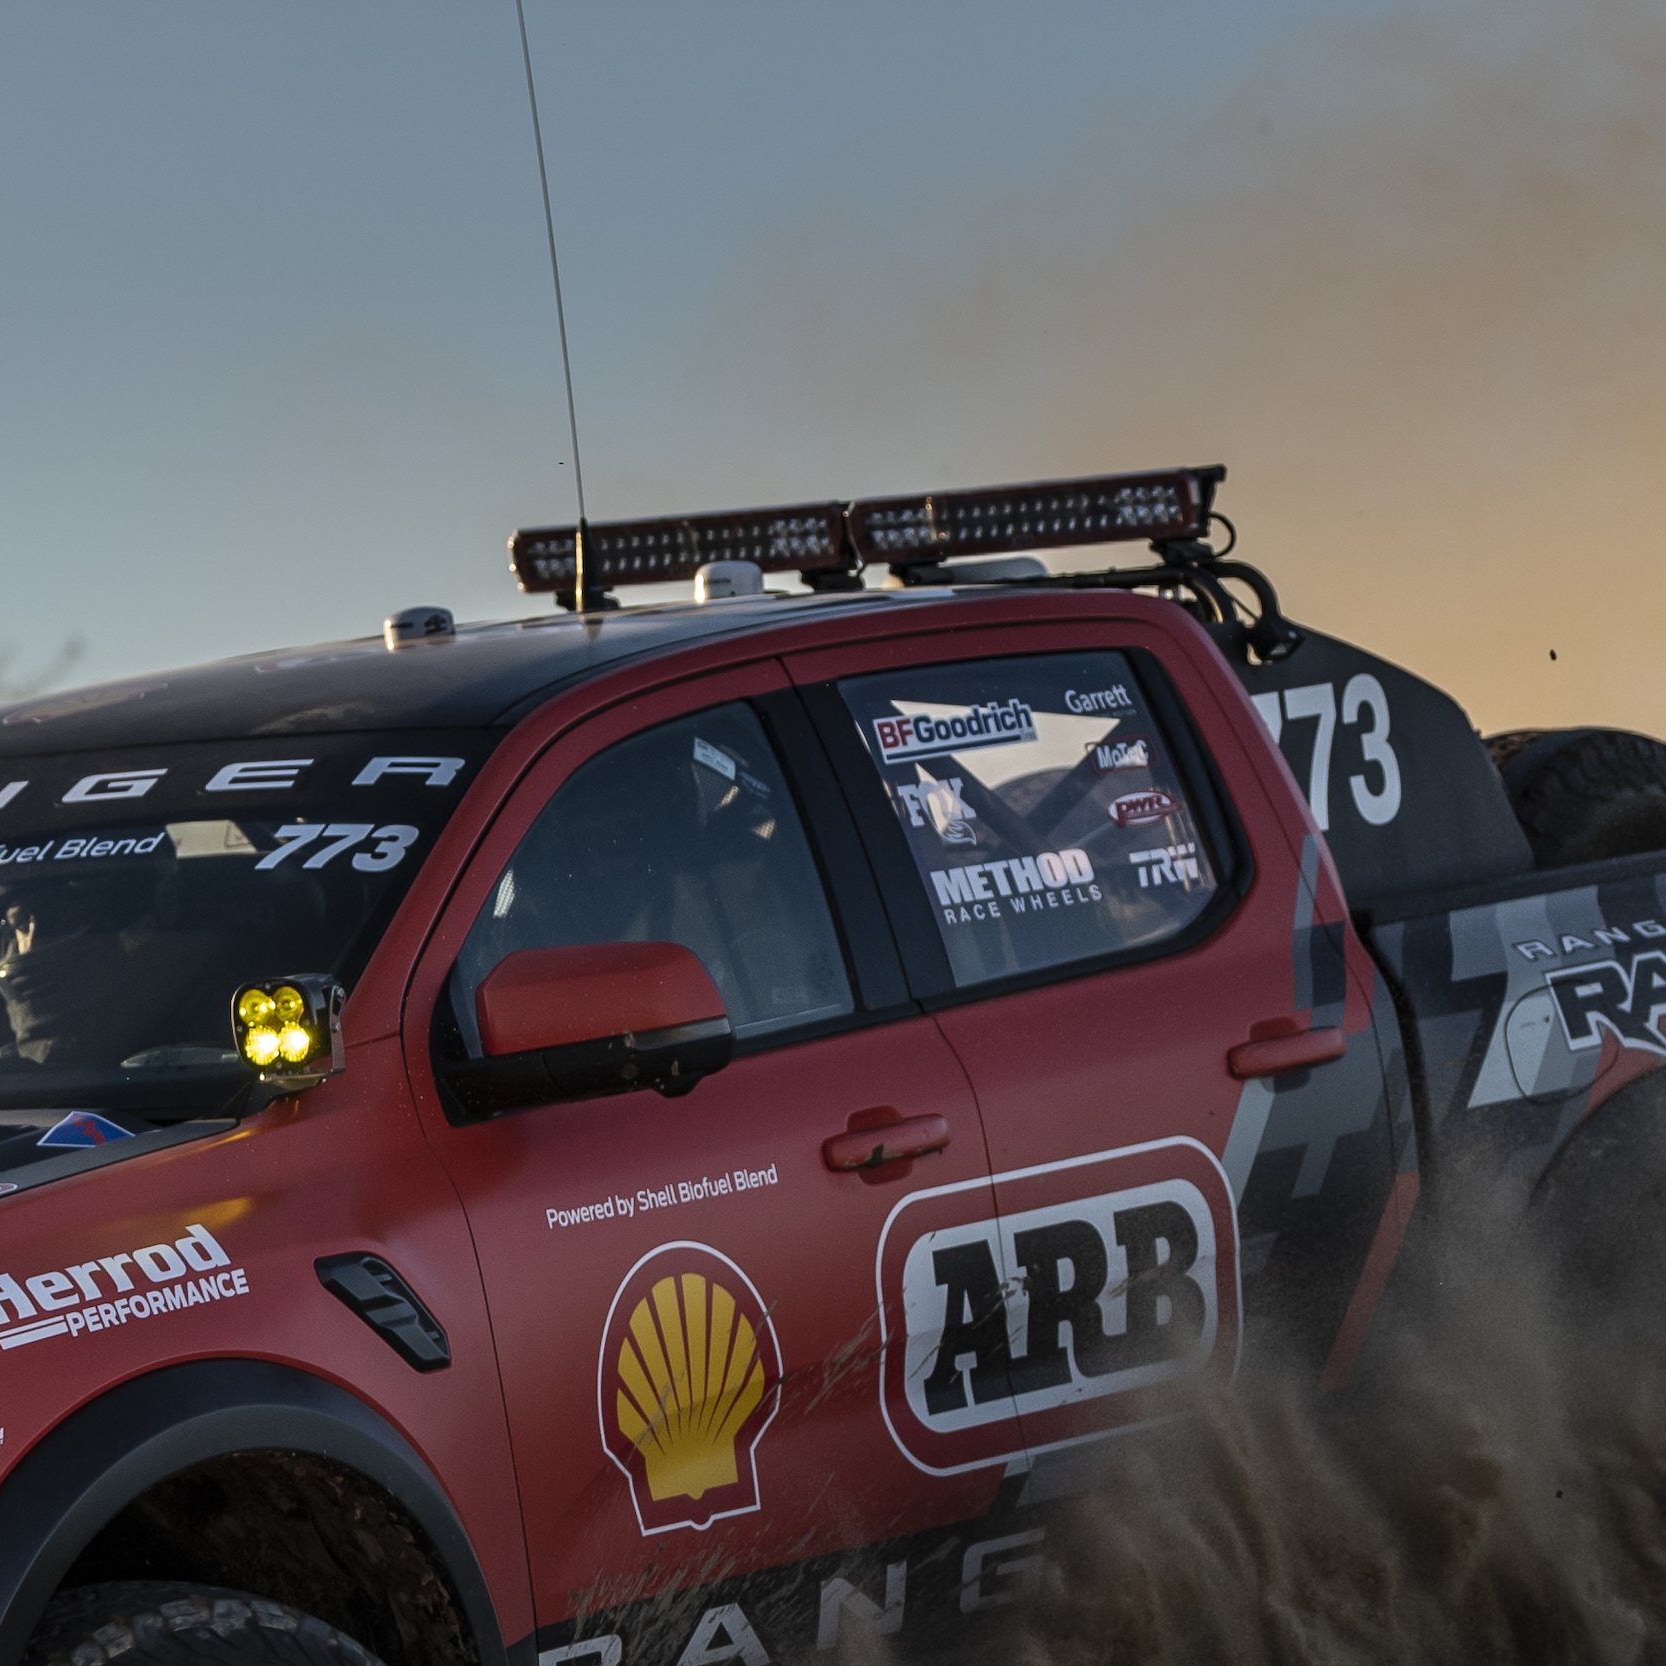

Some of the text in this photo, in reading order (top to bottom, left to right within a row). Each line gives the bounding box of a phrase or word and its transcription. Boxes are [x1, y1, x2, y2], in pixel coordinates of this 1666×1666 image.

[1064, 683, 1133, 713] Garrett
[876, 701, 1033, 749] BFGoodrich
[896, 776, 977, 836] FOX
[54, 832, 167, 861] Blend
[254, 823, 420, 873] 773
[1129, 842, 1199, 888] TRW
[930, 848, 1095, 906] METHOD
[943, 884, 1103, 925] RACE WHEELS
[545, 1162, 779, 1229] Powered by Shell Biofuel Blend
[65, 1268, 250, 1338] PERFORMANCE
[922, 1199, 1208, 1417] ARB
